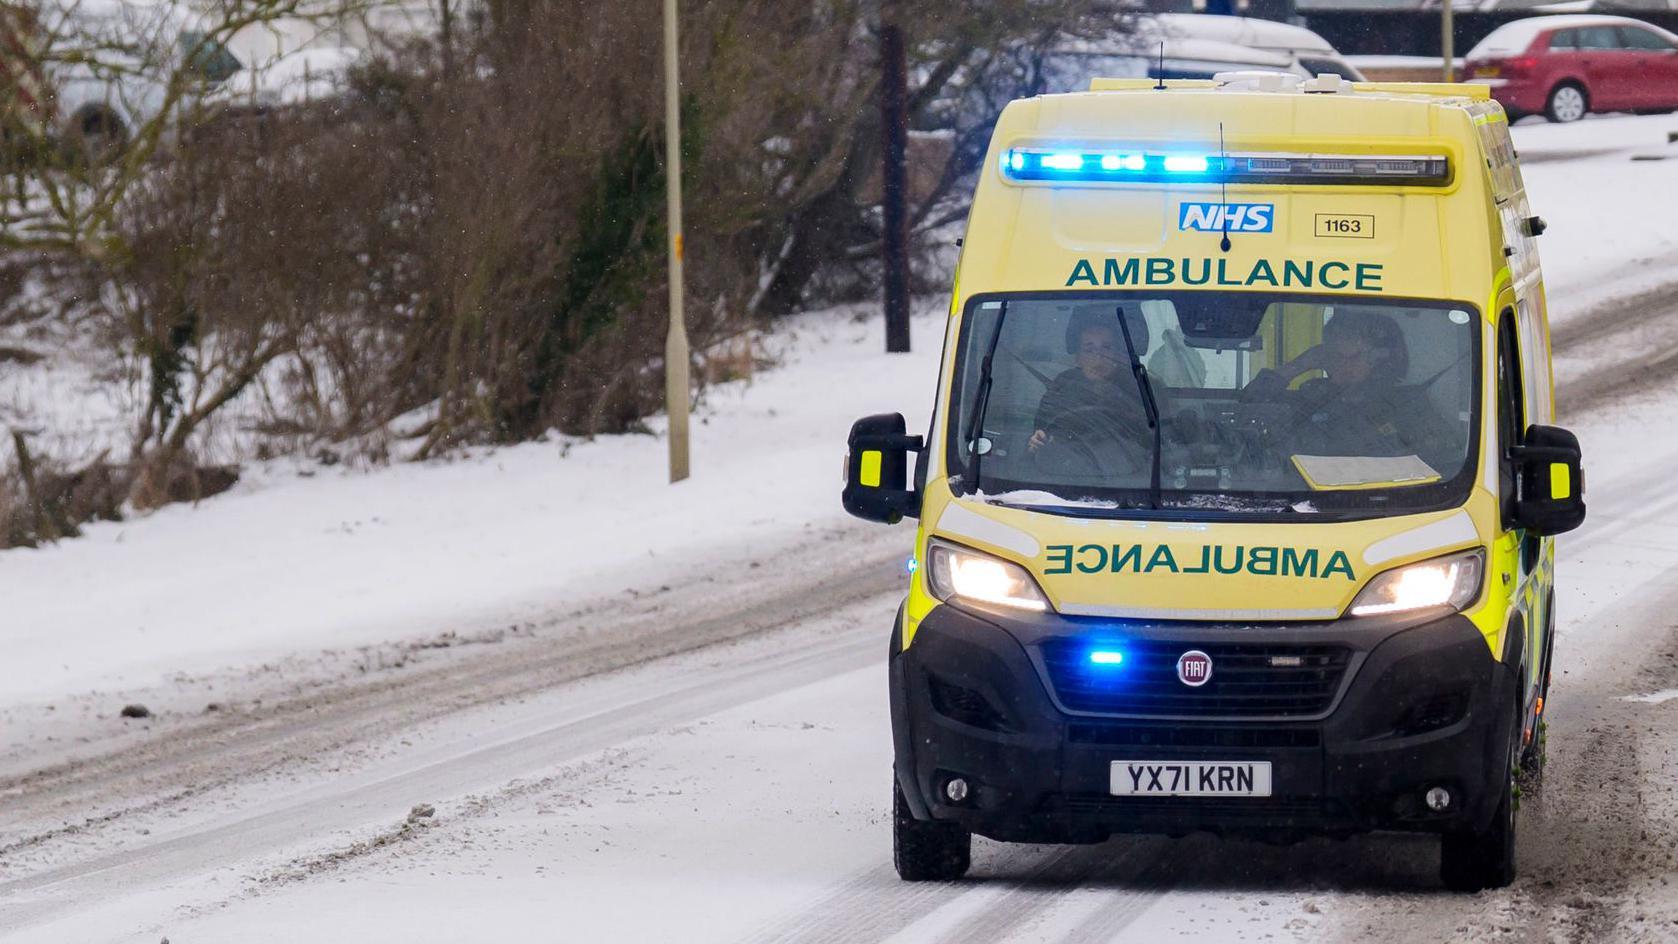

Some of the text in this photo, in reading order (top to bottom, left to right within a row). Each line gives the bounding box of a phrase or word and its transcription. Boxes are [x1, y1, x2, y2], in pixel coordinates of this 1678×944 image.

[1182, 204, 1271, 230] NHS
[1324, 219, 1361, 233] 1163
[1065, 257, 1384, 291] AMBULANCE
[1185, 661, 1206, 677] FIAT
[1128, 765, 1254, 792] YX71 KRN
